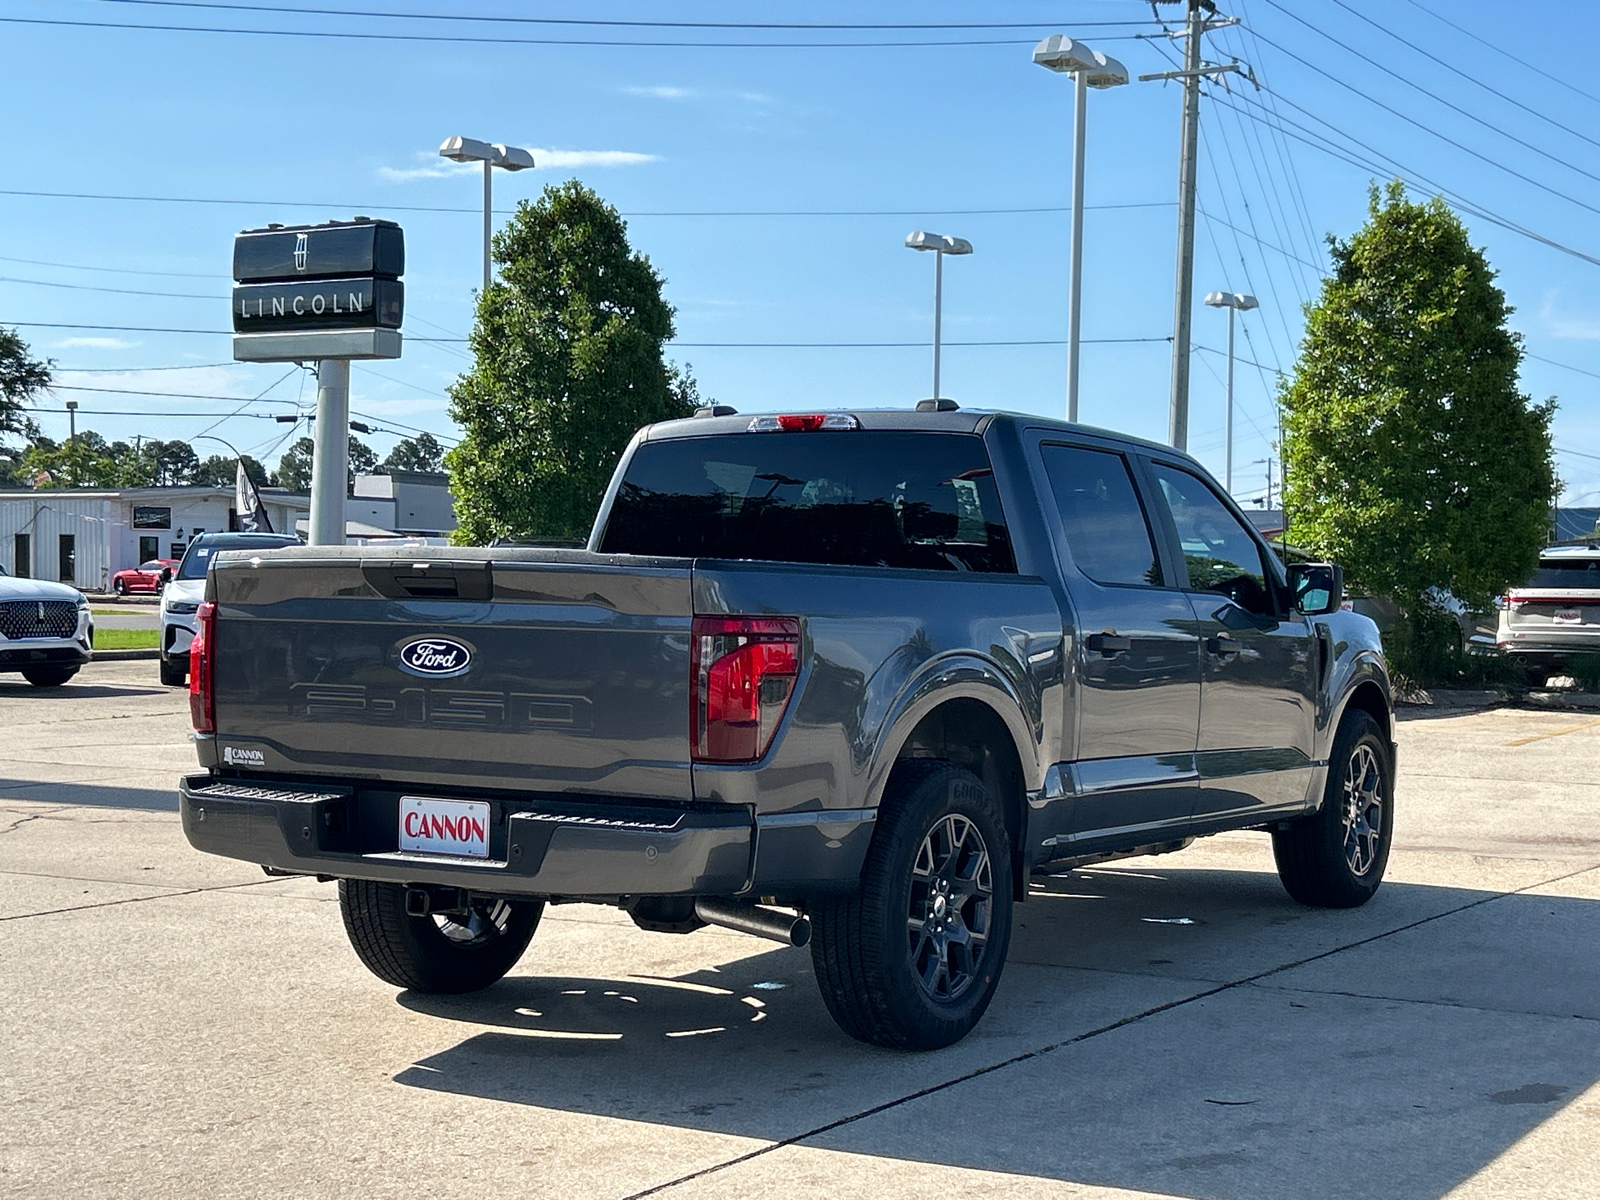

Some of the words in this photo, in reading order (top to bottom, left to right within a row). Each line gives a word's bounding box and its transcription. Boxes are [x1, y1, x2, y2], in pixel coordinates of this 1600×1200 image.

[242, 292, 363, 318] LINCOLN
[412, 643, 457, 667] Ford
[289, 682, 593, 735] F-150
[232, 748, 264, 760] CANNON
[404, 811, 485, 843] CANNON
